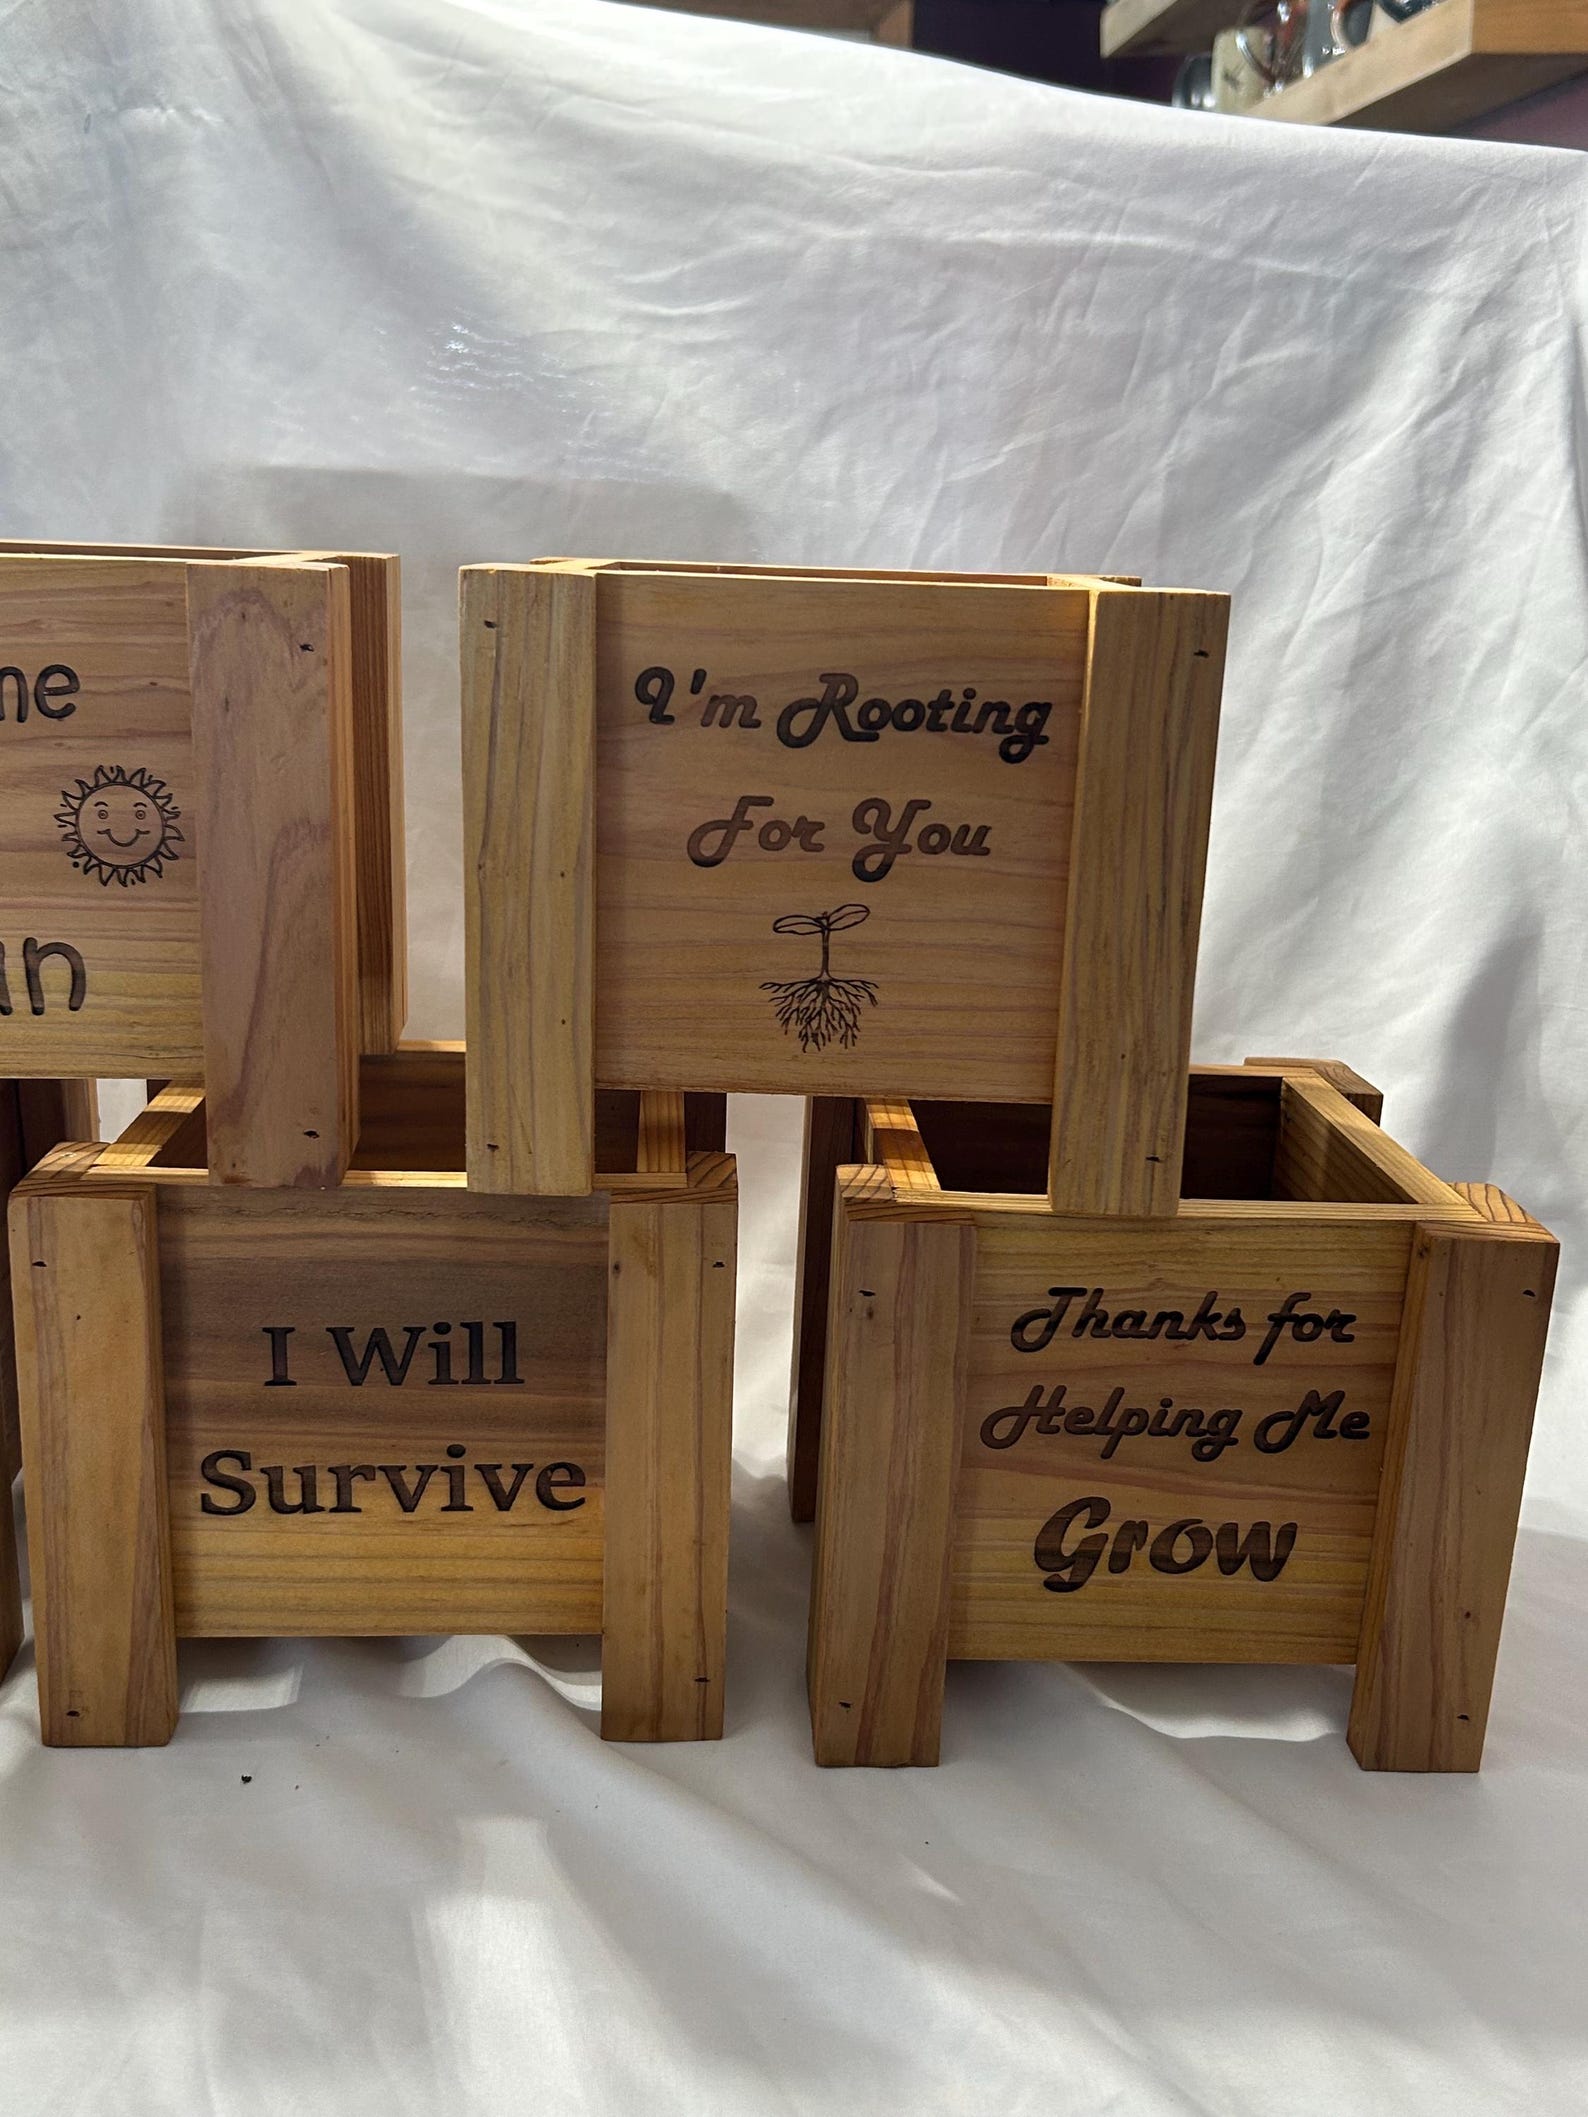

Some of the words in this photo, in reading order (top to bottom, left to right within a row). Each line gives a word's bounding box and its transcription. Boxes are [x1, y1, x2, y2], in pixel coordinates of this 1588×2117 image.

[634, 667, 762, 728] I'm
[776, 673, 1053, 764] Rooting
[687, 796, 826, 868] For
[851, 798, 992, 882] You
[262, 1327, 297, 1386] I
[326, 1321, 525, 1386] Will
[1011, 1287, 1247, 1353] Thanks
[1253, 1292, 1357, 1366] for
[980, 1384, 1243, 1462] Helping
[1253, 1389, 1370, 1454] Me
[201, 1443, 586, 1515] Survive
[1034, 1496, 1299, 1593] Grow
